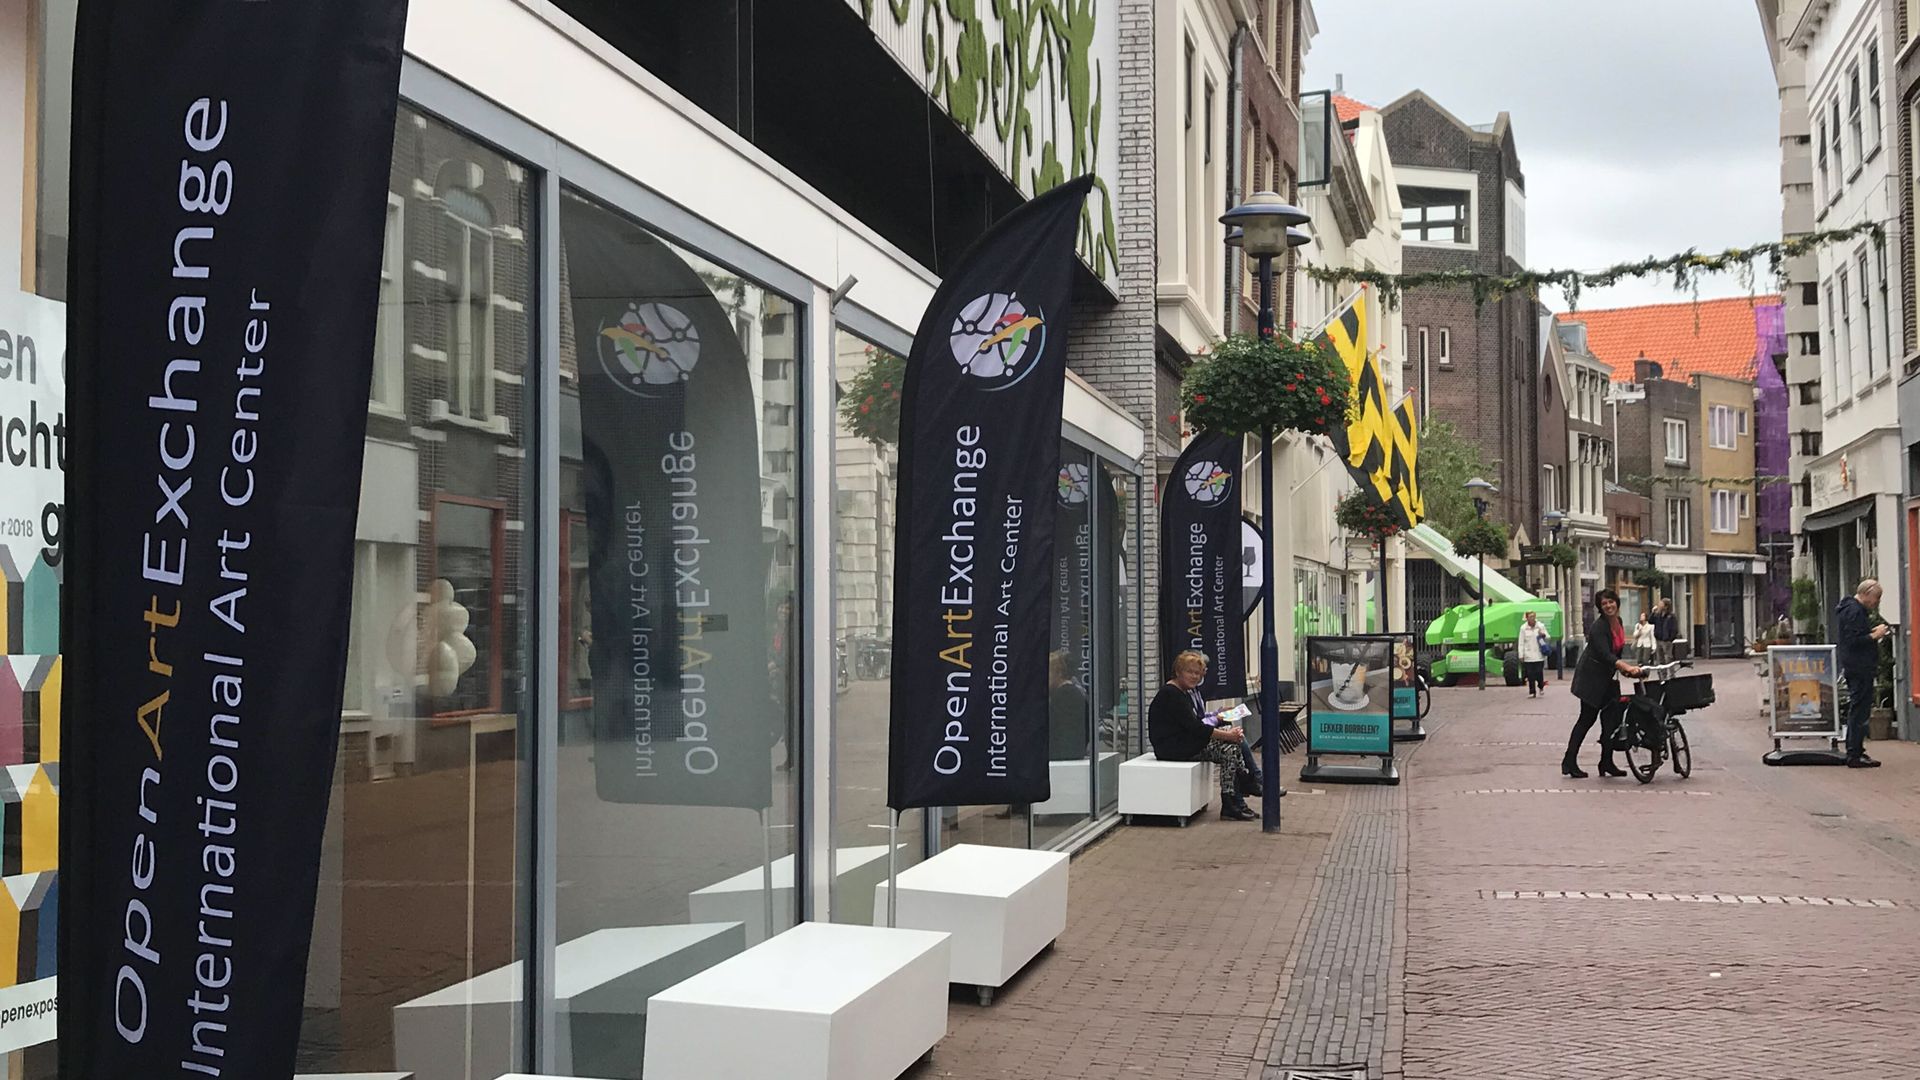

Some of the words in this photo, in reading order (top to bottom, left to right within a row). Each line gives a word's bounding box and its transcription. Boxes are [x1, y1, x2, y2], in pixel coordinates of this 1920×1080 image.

[220, 288, 271, 507] Center
[0, 400, 66, 473] cht
[8, 518, 33, 537] 2018
[1001, 494, 1023, 573] Center
[115, 97, 233, 1044] OpenArtExchange
[209, 529, 251, 634] Art
[933, 425, 987, 775] OpenArtExchange
[997, 580, 1013, 616] Art
[1186, 523, 1208, 687] nArtExchange
[1213, 553, 1224, 592] Center
[1213, 594, 1225, 612] Art
[1213, 615, 1228, 686] International
[986, 624, 1009, 777] International
[1320, 722, 1344, 734] LEKKER
[181, 652, 244, 1078] International
[0, 996, 58, 1029] penexpos
